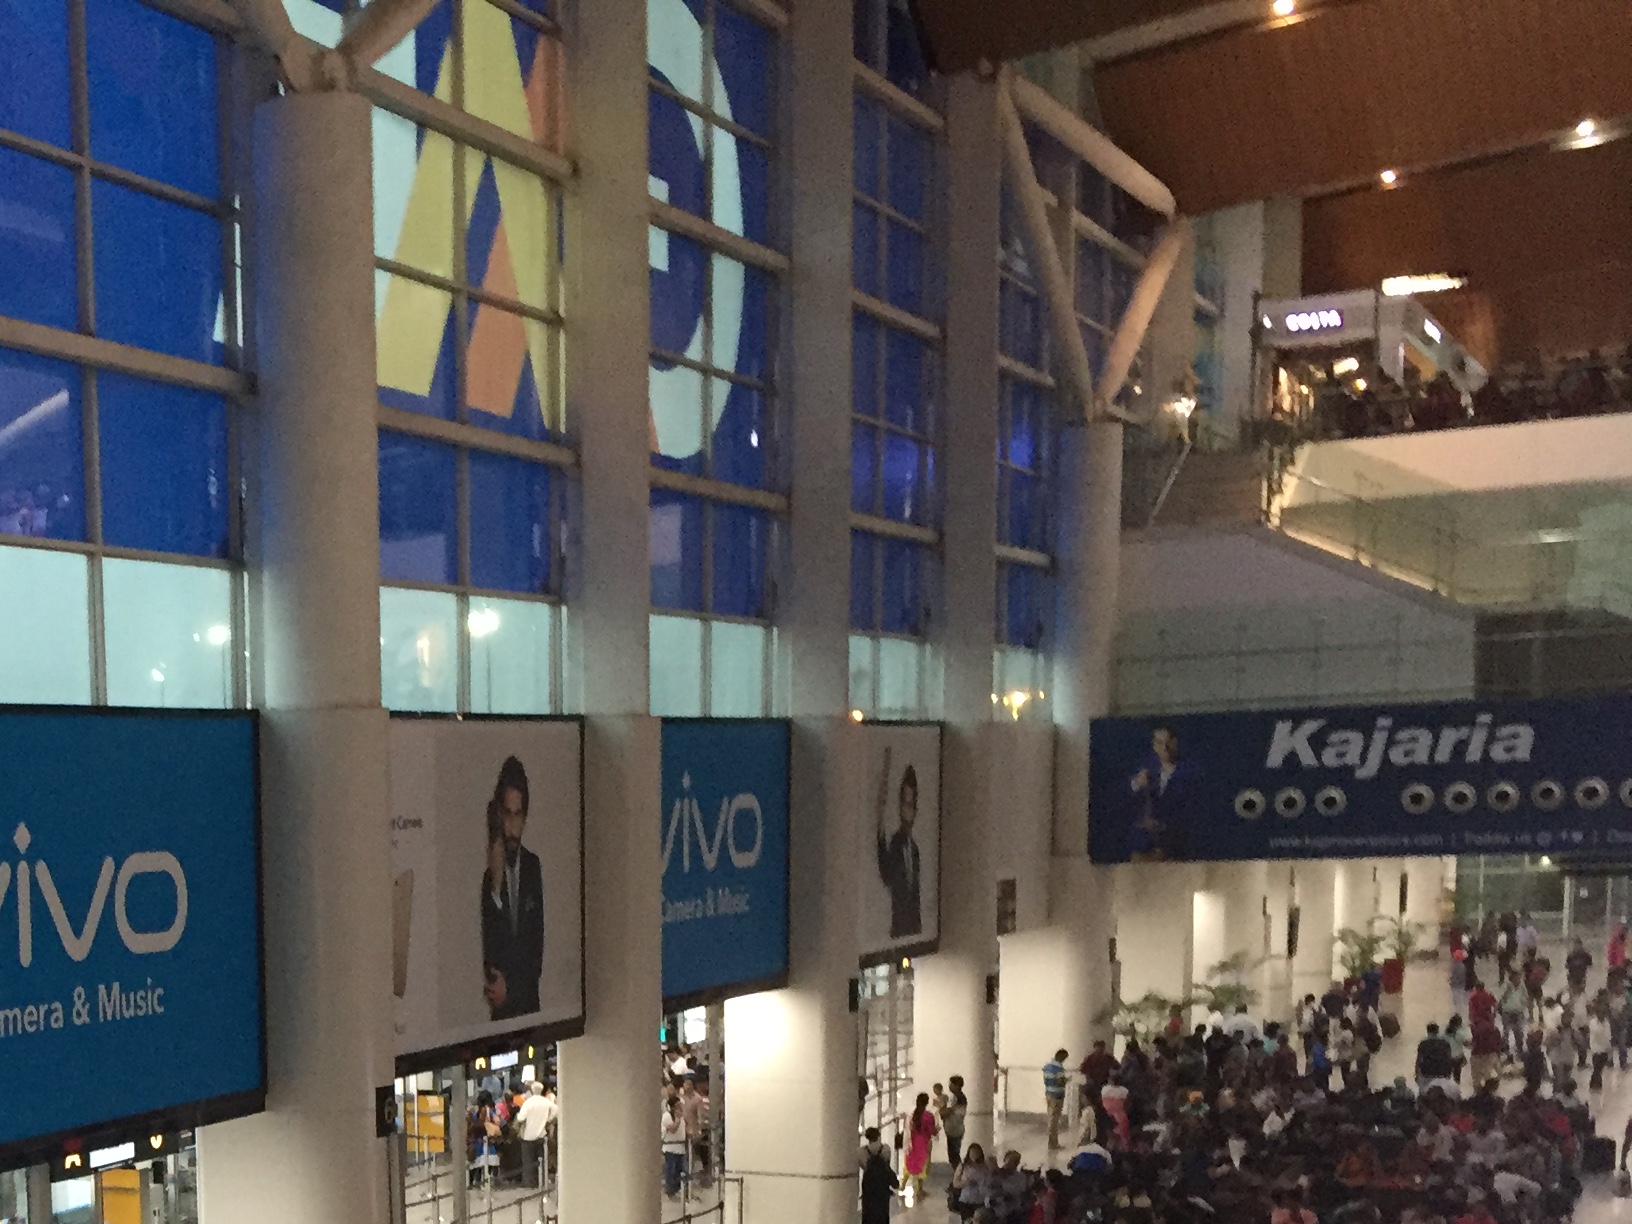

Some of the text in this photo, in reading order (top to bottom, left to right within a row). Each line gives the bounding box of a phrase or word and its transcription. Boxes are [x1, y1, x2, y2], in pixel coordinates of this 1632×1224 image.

[1266, 712, 1534, 780] Kajaria
[72, 985, 91, 1026] &
[97, 977, 166, 1022] Music
